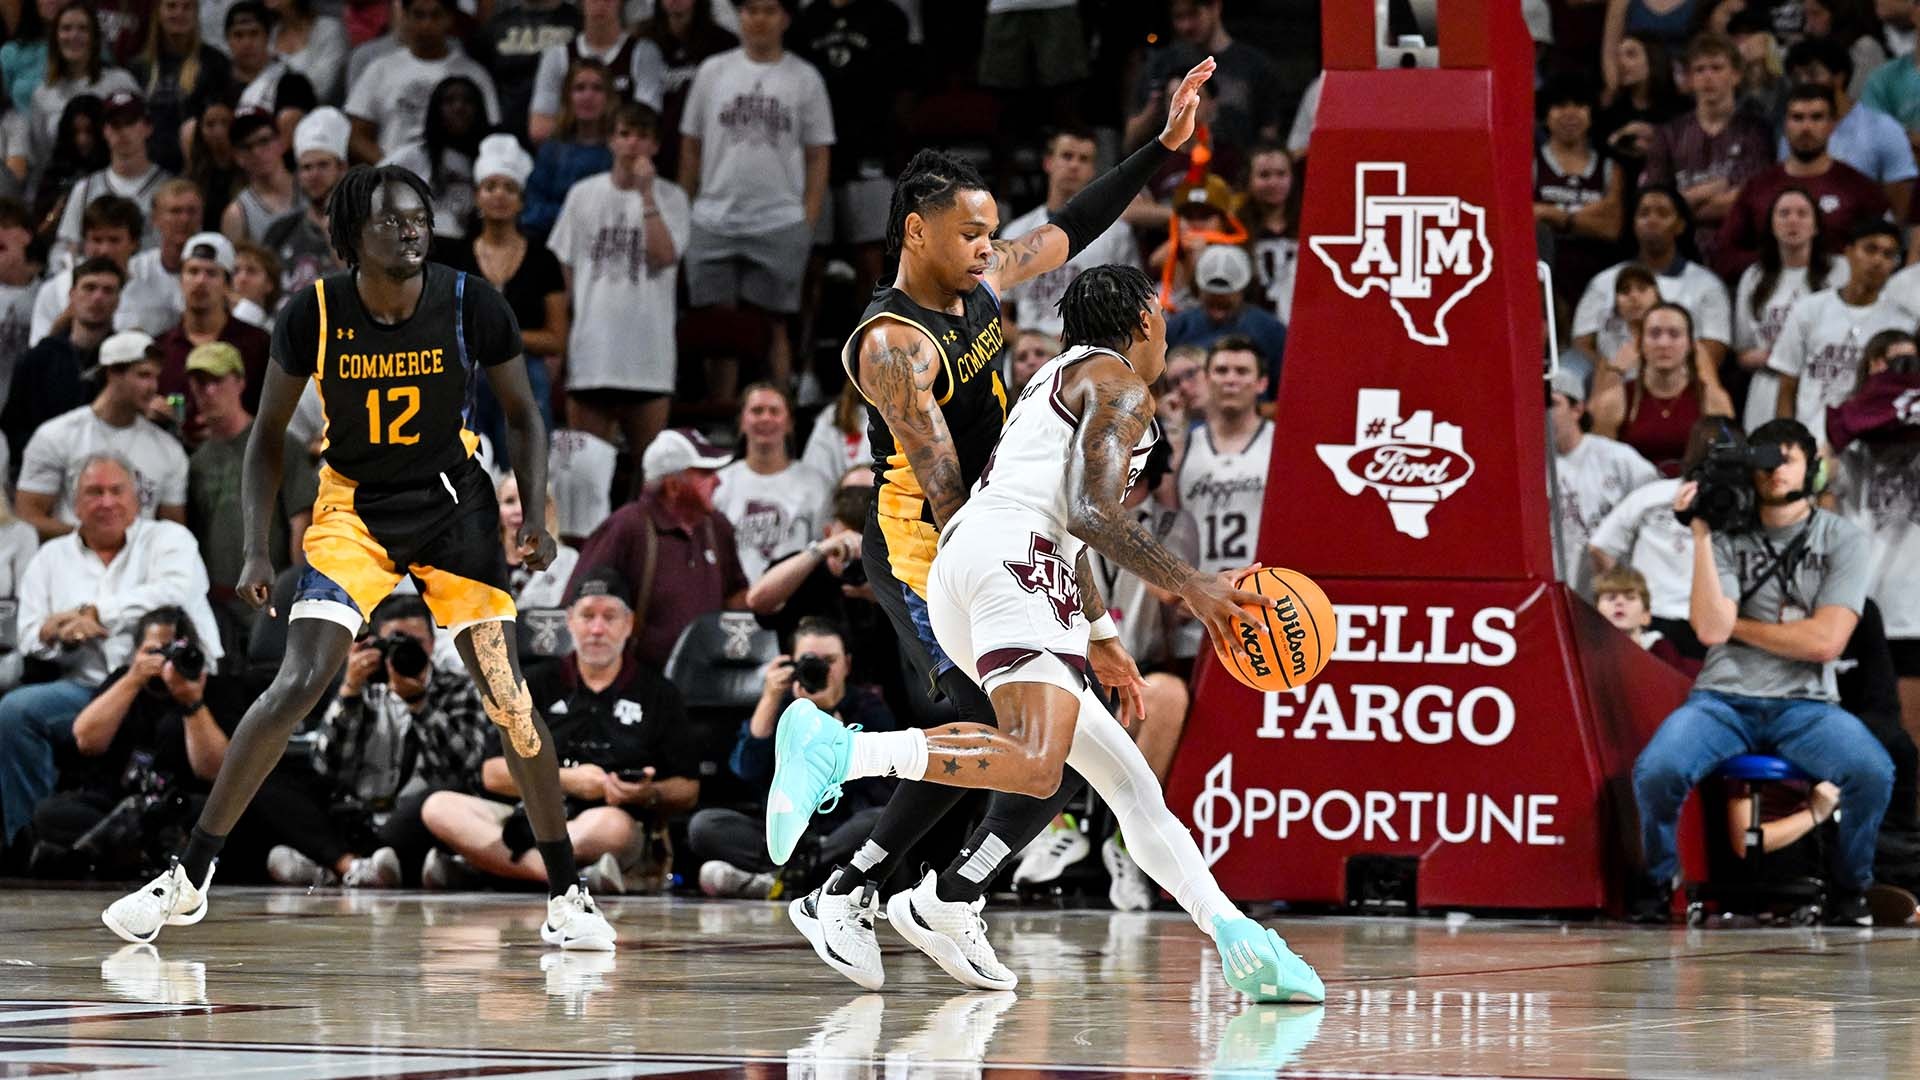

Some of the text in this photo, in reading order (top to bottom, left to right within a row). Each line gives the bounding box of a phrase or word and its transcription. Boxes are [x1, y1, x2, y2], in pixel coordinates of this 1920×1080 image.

[340, 348, 444, 379] COMMERCE
[957, 317, 1004, 384] COMMERC
[366, 385, 420, 446] 12
[1364, 409, 1434, 442] #1
[1364, 446, 1451, 484] Ford
[1205, 511, 1247, 560] 12
[1240, 622, 1271, 677] NCAA
[1275, 595, 1306, 676] Wilson
[1331, 604, 1517, 667] ELLS
[1257, 683, 1516, 746] FARGO
